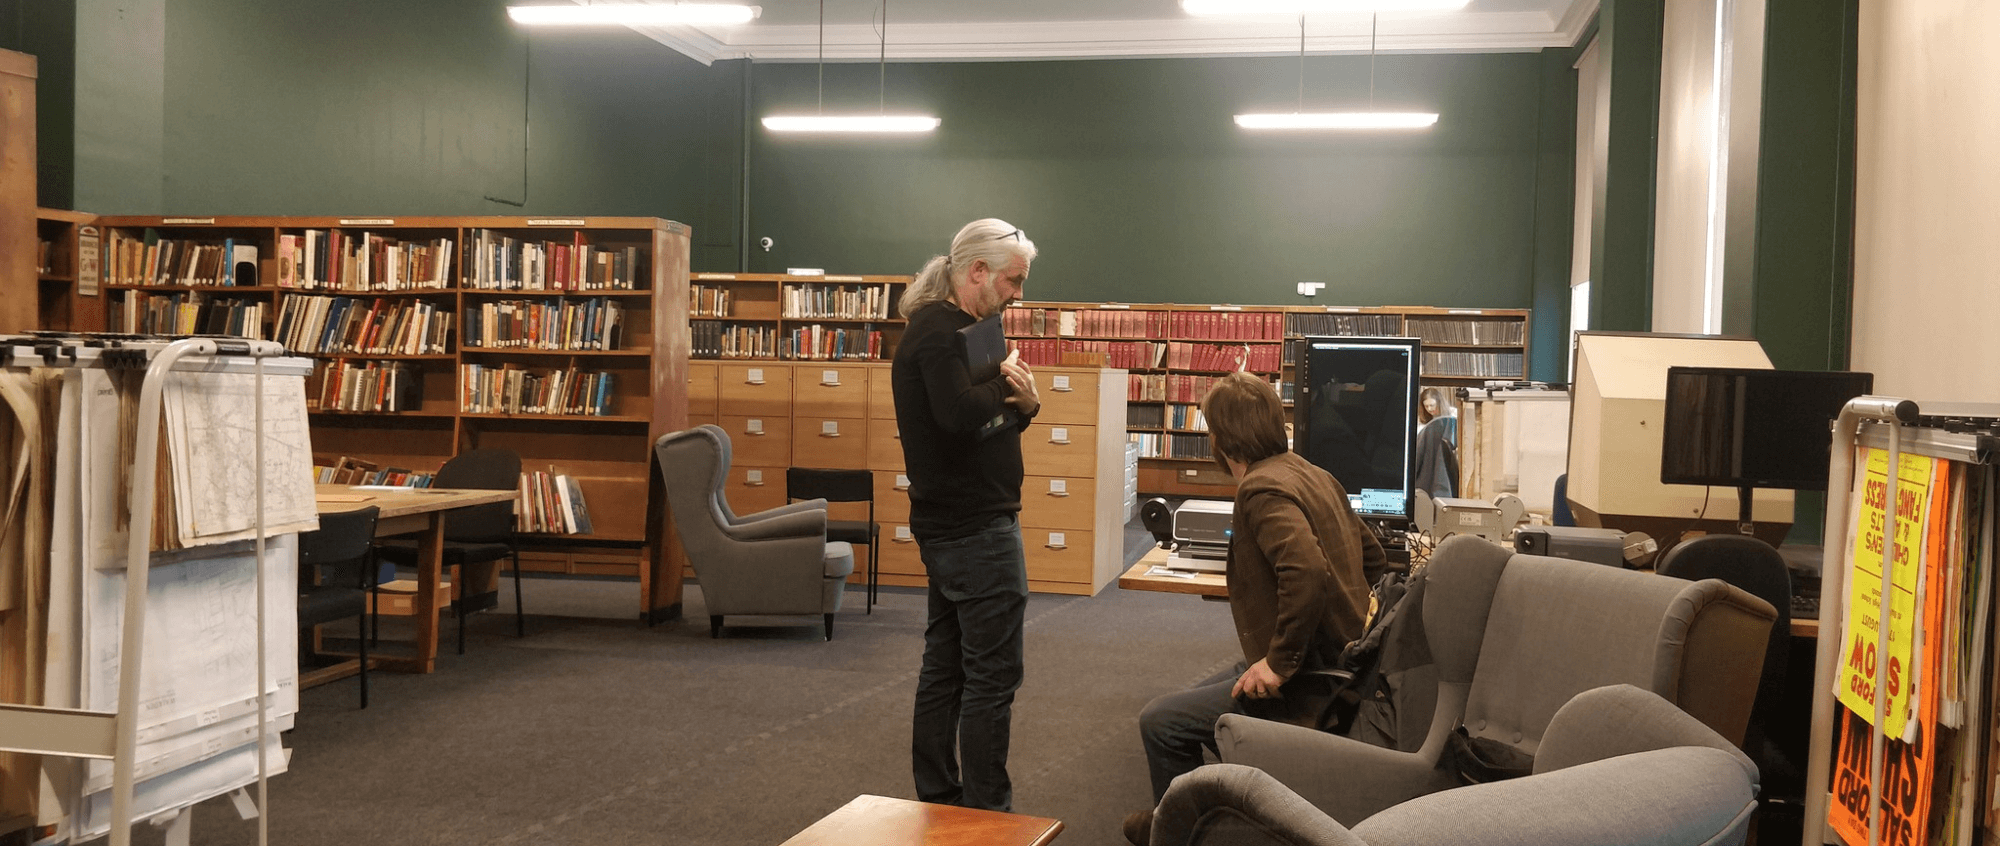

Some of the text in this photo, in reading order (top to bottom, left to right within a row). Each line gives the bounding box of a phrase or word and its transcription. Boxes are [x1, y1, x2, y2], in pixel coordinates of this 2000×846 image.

[1865, 479, 1922, 523] FANC RESS
[1871, 511, 1902, 538] ALTS
[1849, 633, 1900, 697] SOW
[1851, 674, 1893, 717] SFORD
[1843, 708, 1923, 817] SHW
[1838, 767, 1912, 846] SALORD
